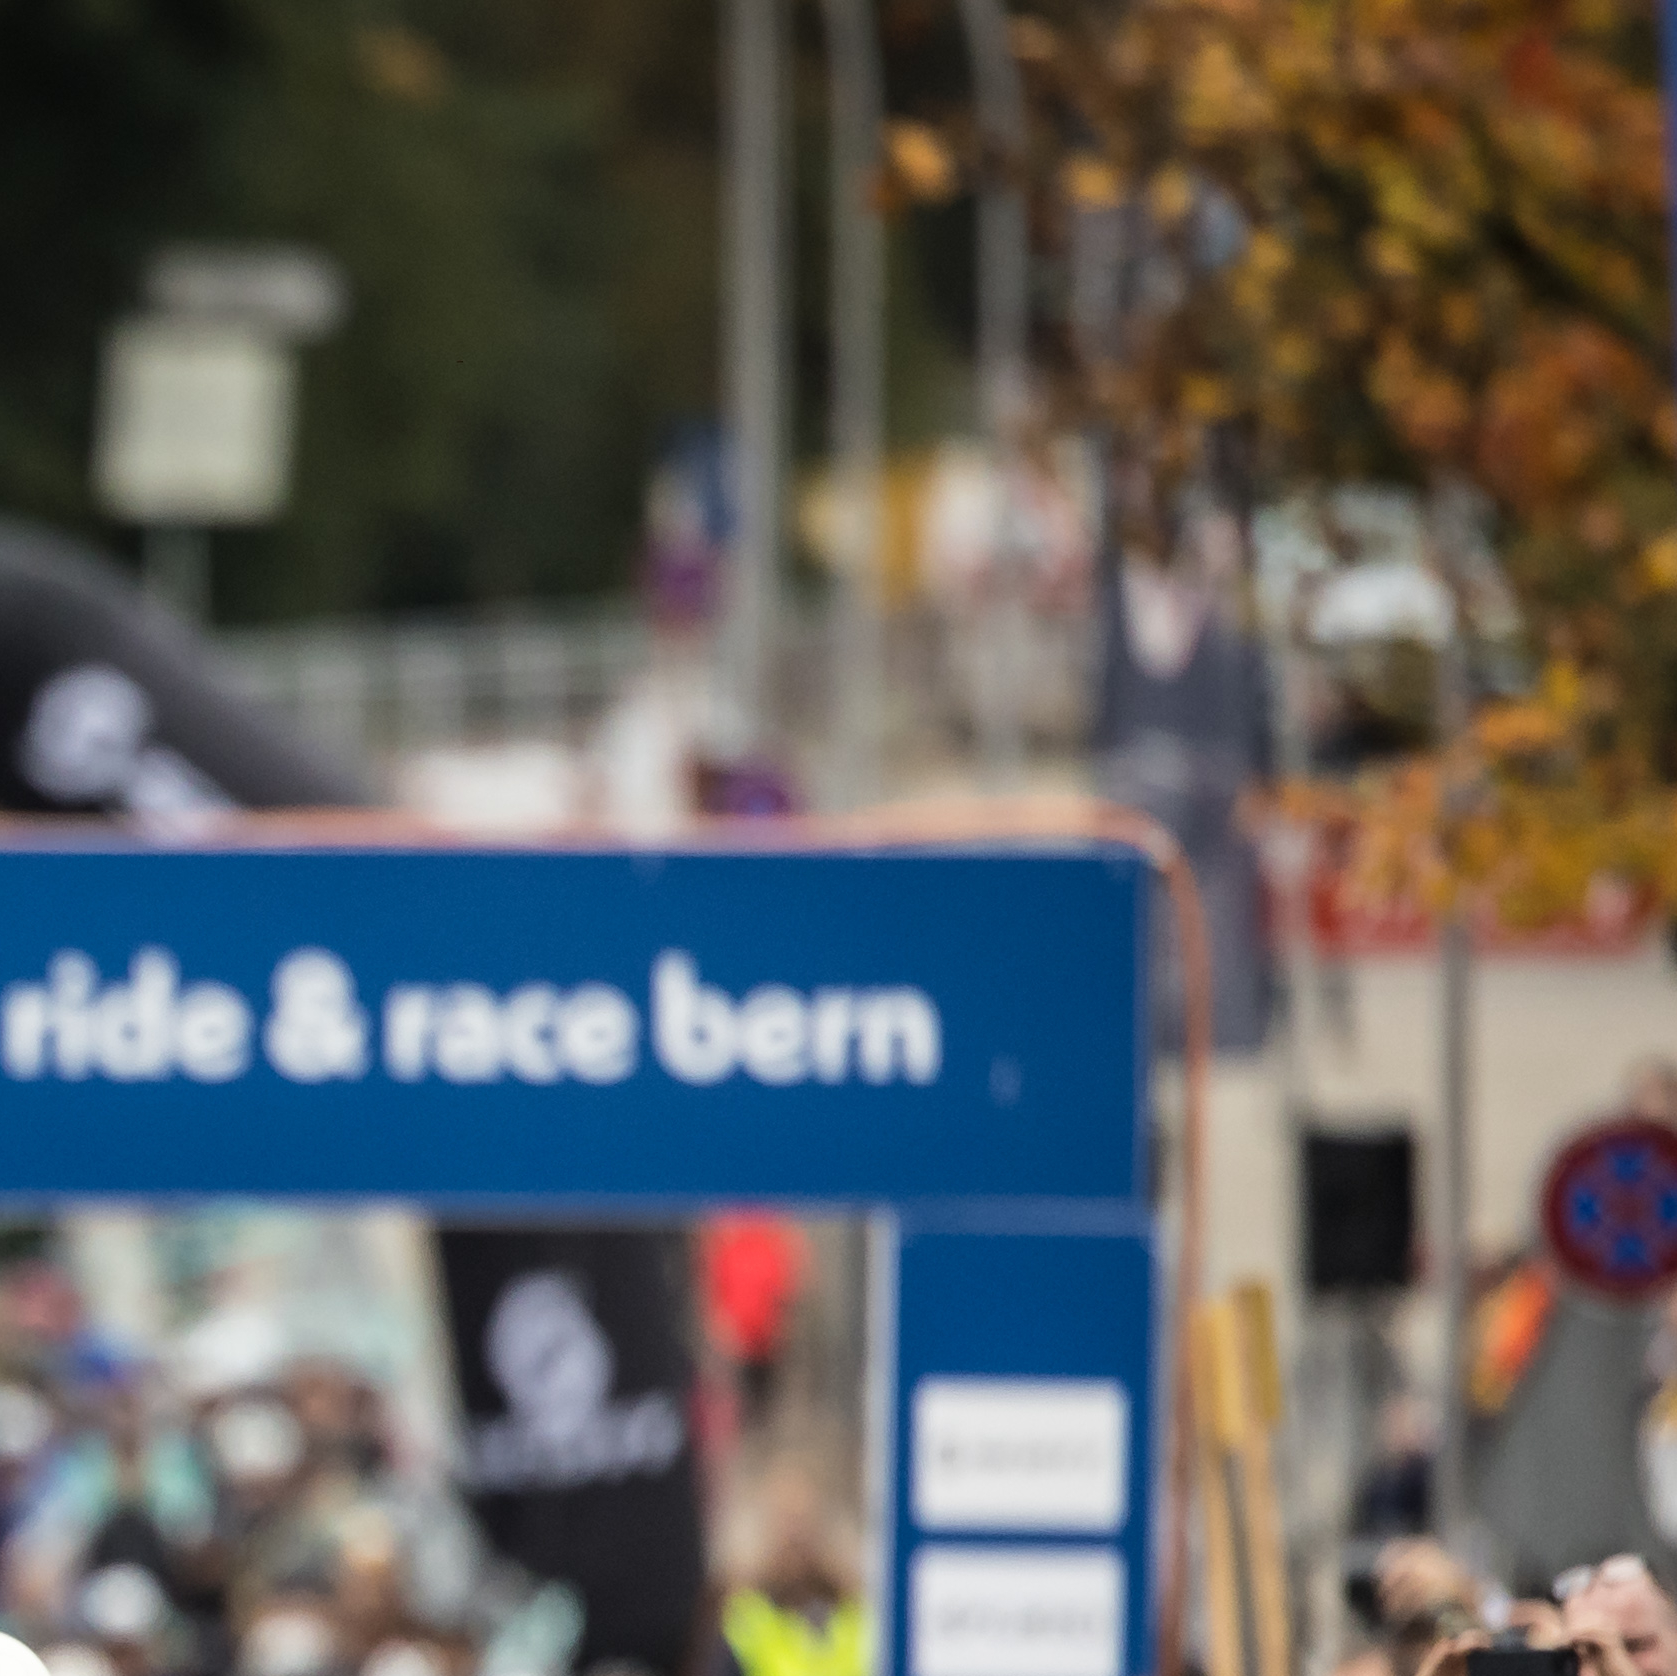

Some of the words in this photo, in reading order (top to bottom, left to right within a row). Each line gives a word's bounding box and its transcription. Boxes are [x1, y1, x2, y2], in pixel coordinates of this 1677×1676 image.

[0, 944, 253, 1082] ride
[265, 946, 369, 1082] &
[383, 980, 639, 1085] race
[651, 949, 943, 1087] bern
